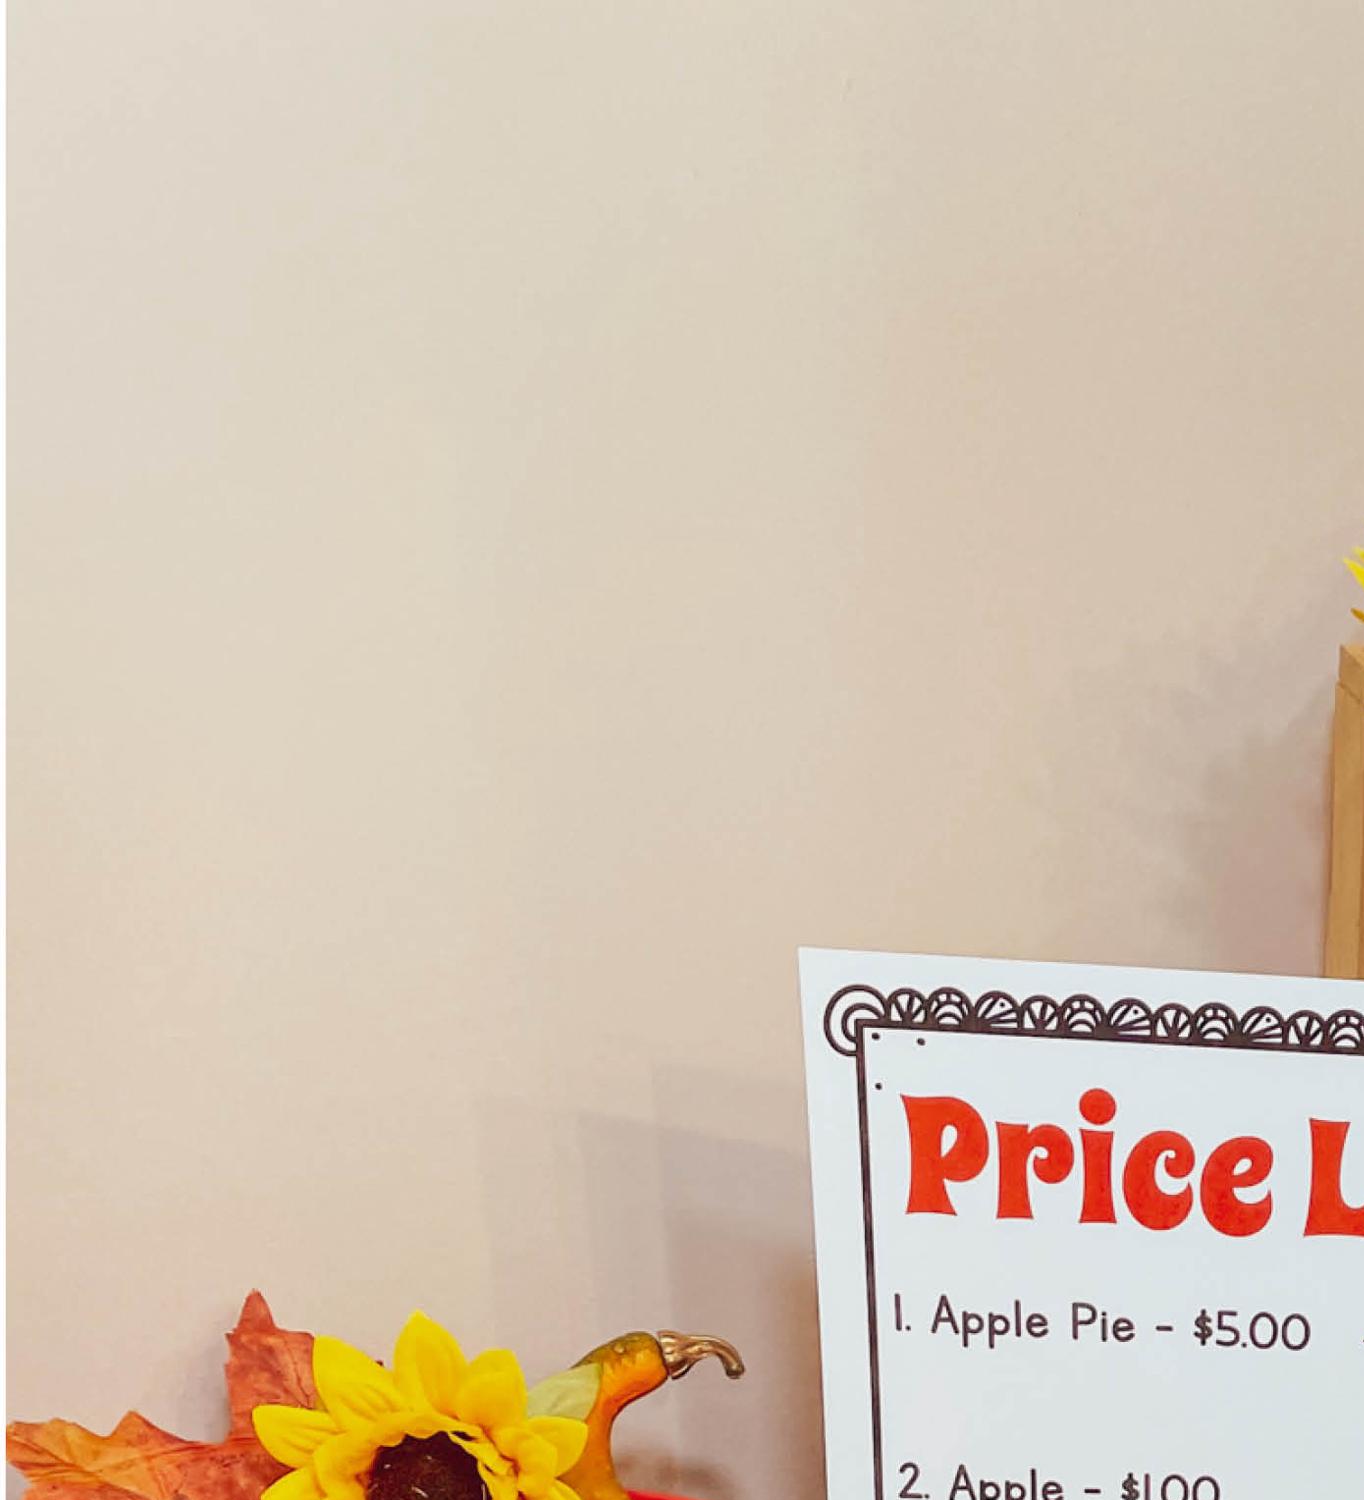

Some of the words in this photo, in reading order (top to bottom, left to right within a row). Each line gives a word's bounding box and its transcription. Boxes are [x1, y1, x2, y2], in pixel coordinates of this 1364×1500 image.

[900, 1087, 1274, 1238] Price
[895, 1293, 911, 1332] 1.
[931, 1293, 1049, 1349] Apple
[1072, 1302, 1136, 1343] Pie
[1193, 1311, 1311, 1352] $5.00
